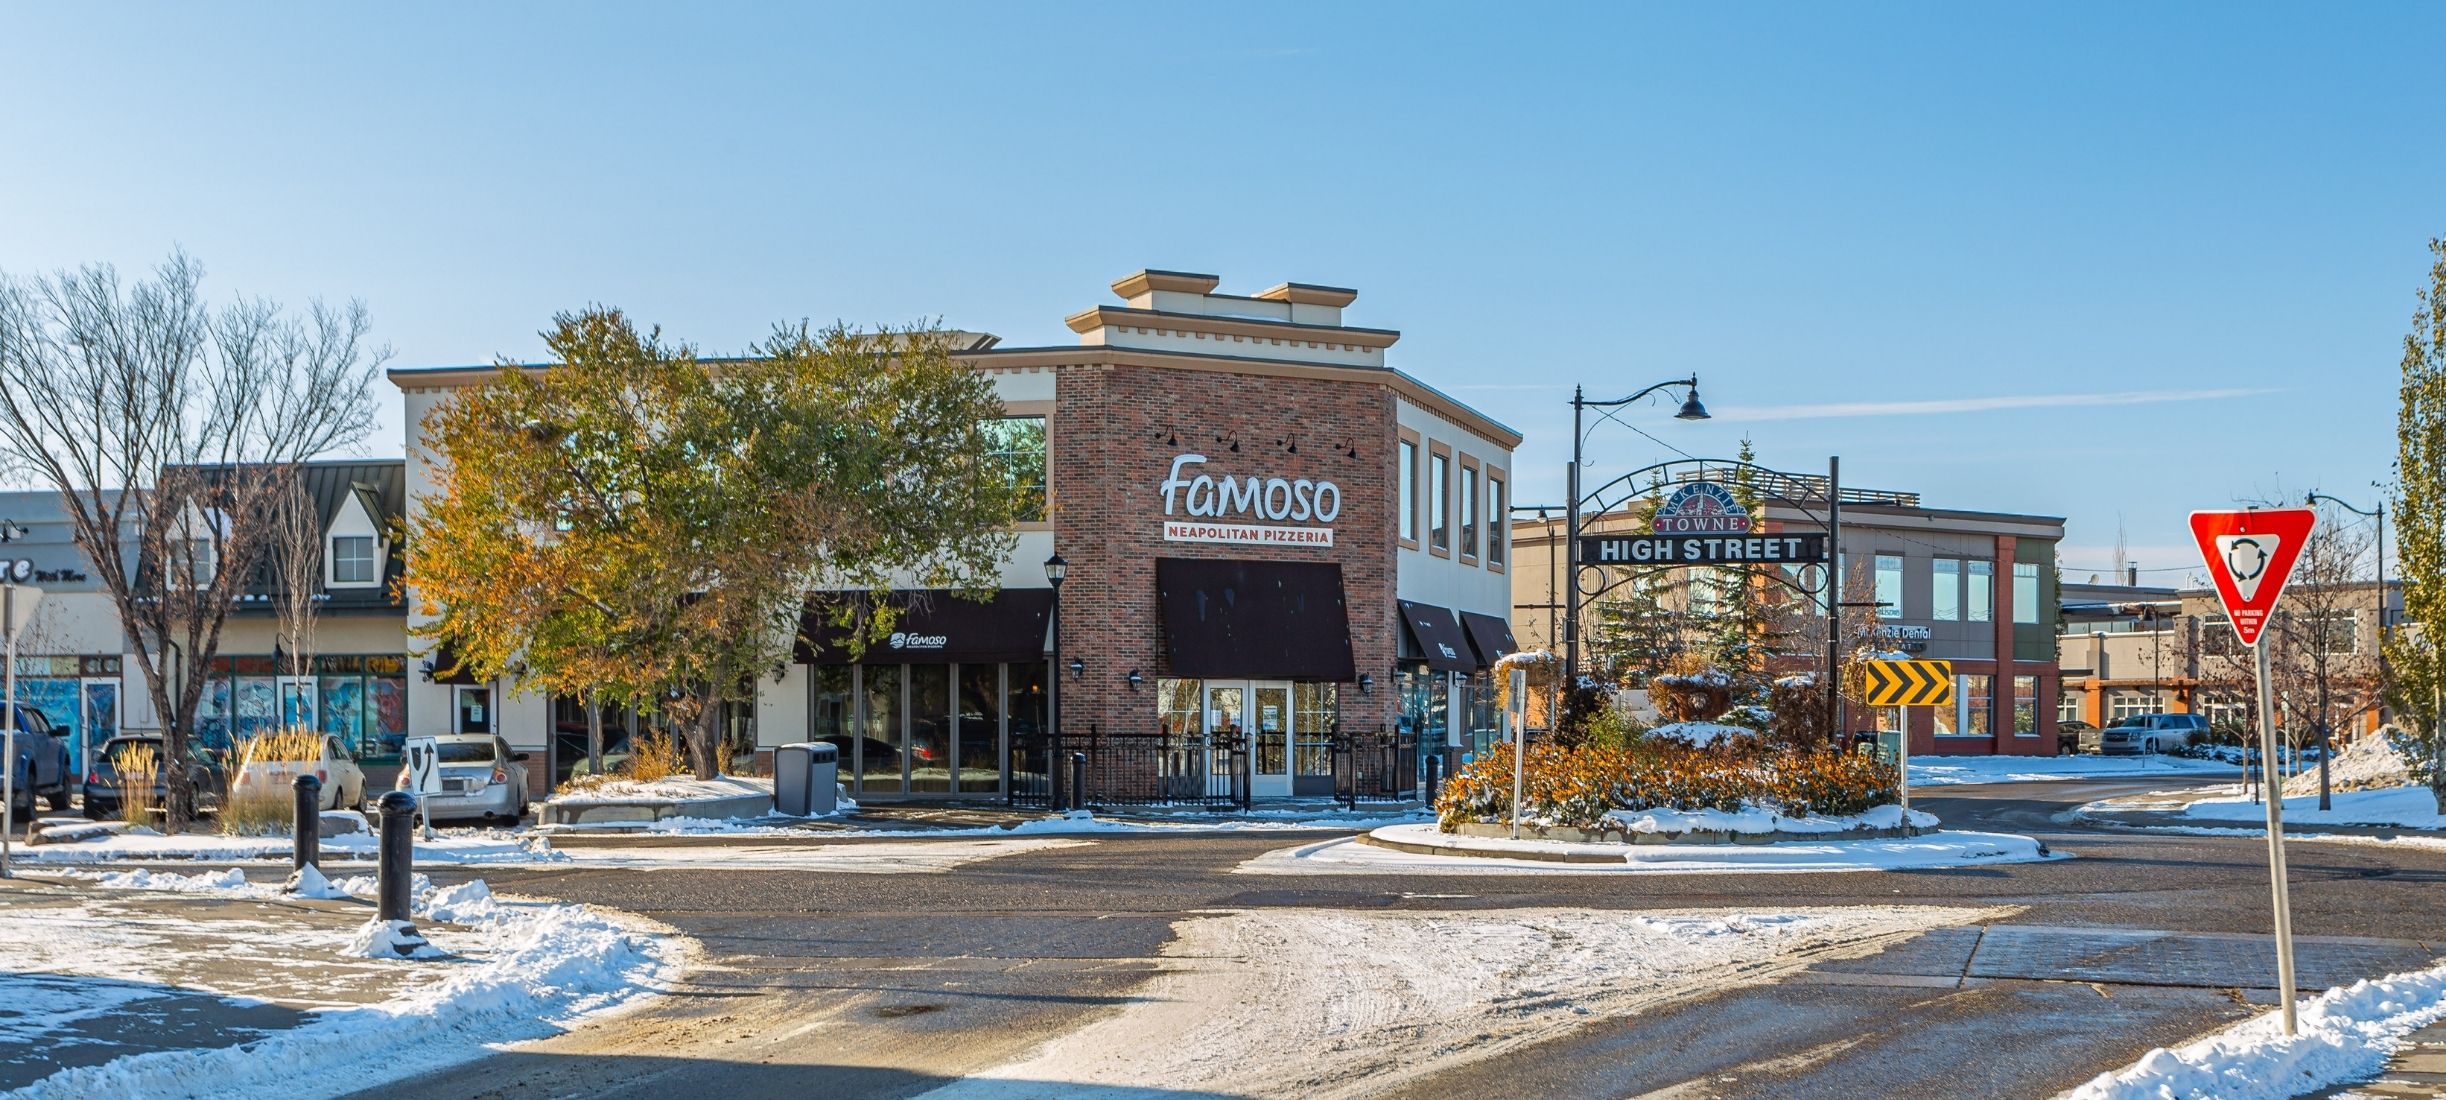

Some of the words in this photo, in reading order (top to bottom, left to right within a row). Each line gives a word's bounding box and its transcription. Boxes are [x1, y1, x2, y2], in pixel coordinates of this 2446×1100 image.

[1663, 518, 1739, 532] TOWNE
[1168, 526, 1259, 541] NEAPOLITAN
[1264, 529, 1329, 543] PIZZERIA
[1600, 539, 1673, 561] HIGH
[1684, 537, 1801, 561] STREET
[1902, 627, 1931, 640] Dental
